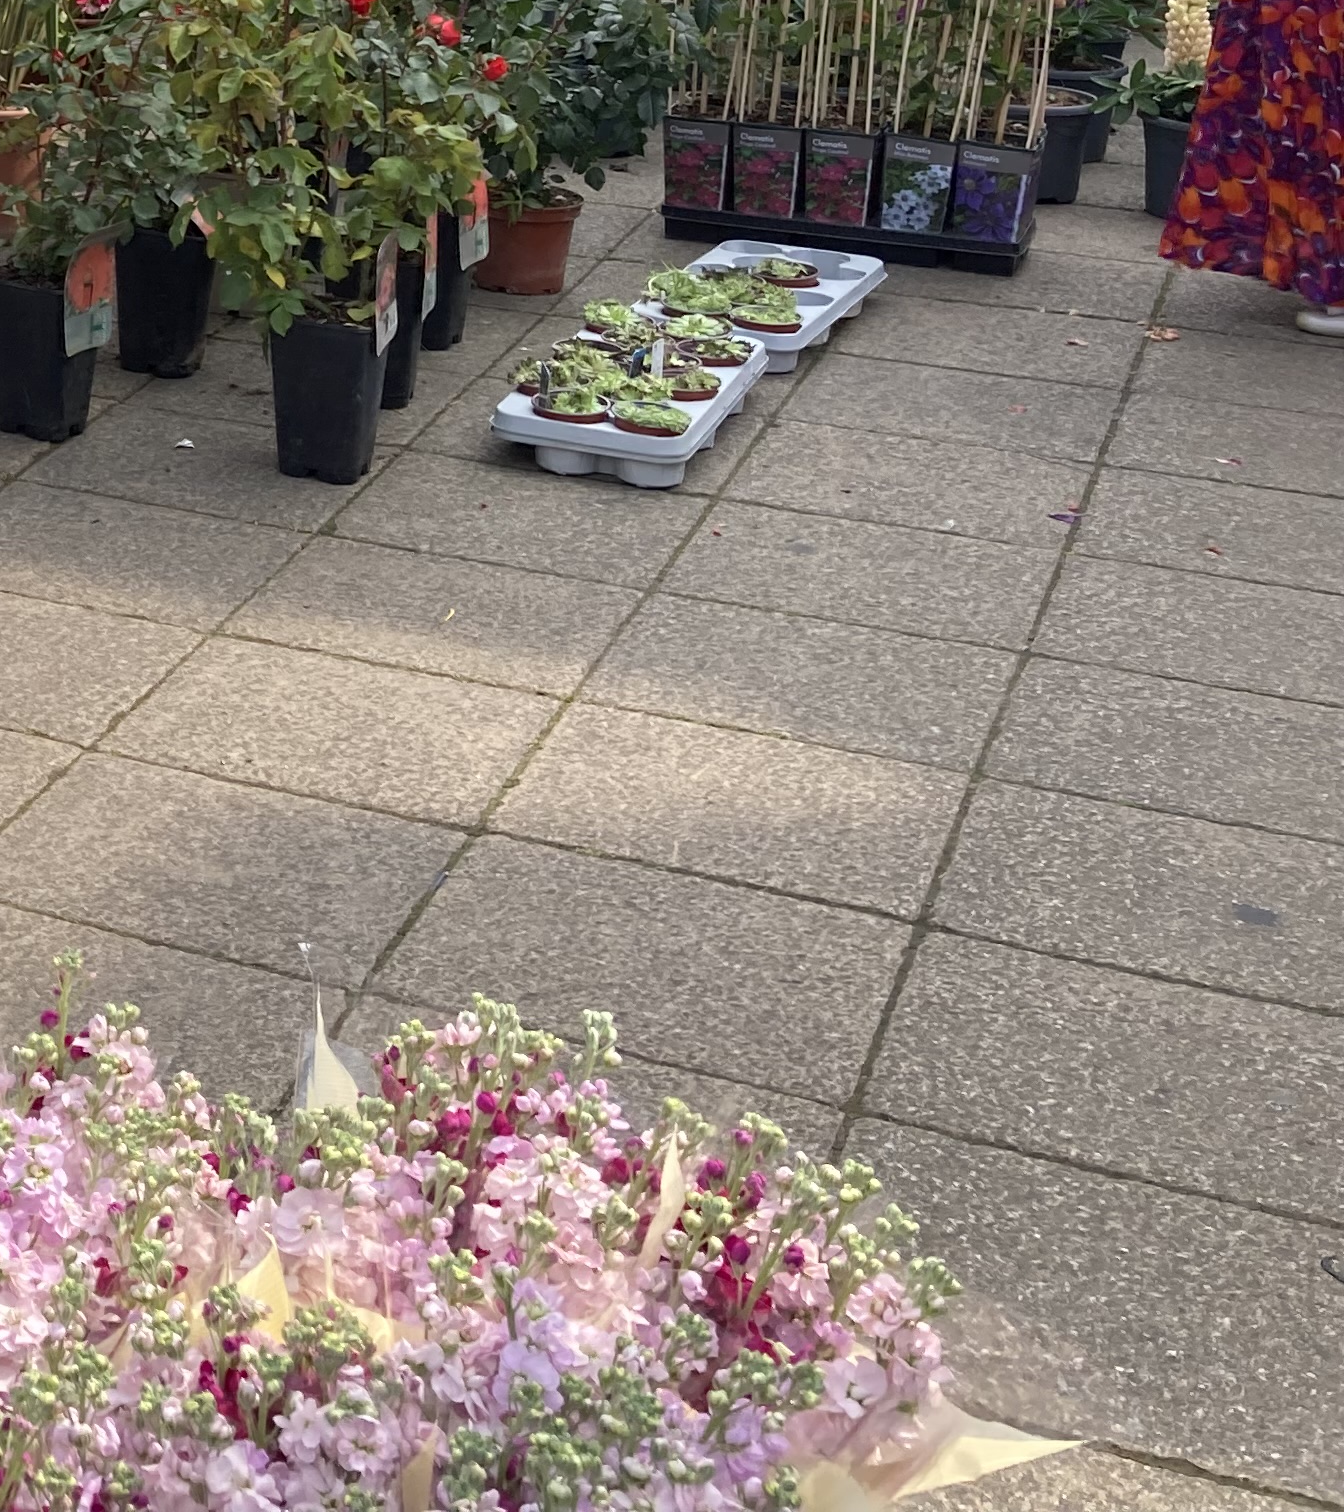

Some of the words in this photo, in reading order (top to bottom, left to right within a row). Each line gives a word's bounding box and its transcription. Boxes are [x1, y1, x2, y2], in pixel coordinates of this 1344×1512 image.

[740, 132, 774, 143] Clematis
[812, 138, 848, 149] Clematis
[895, 142, 932, 155] Clematis
[963, 150, 1000, 164] Clematis
